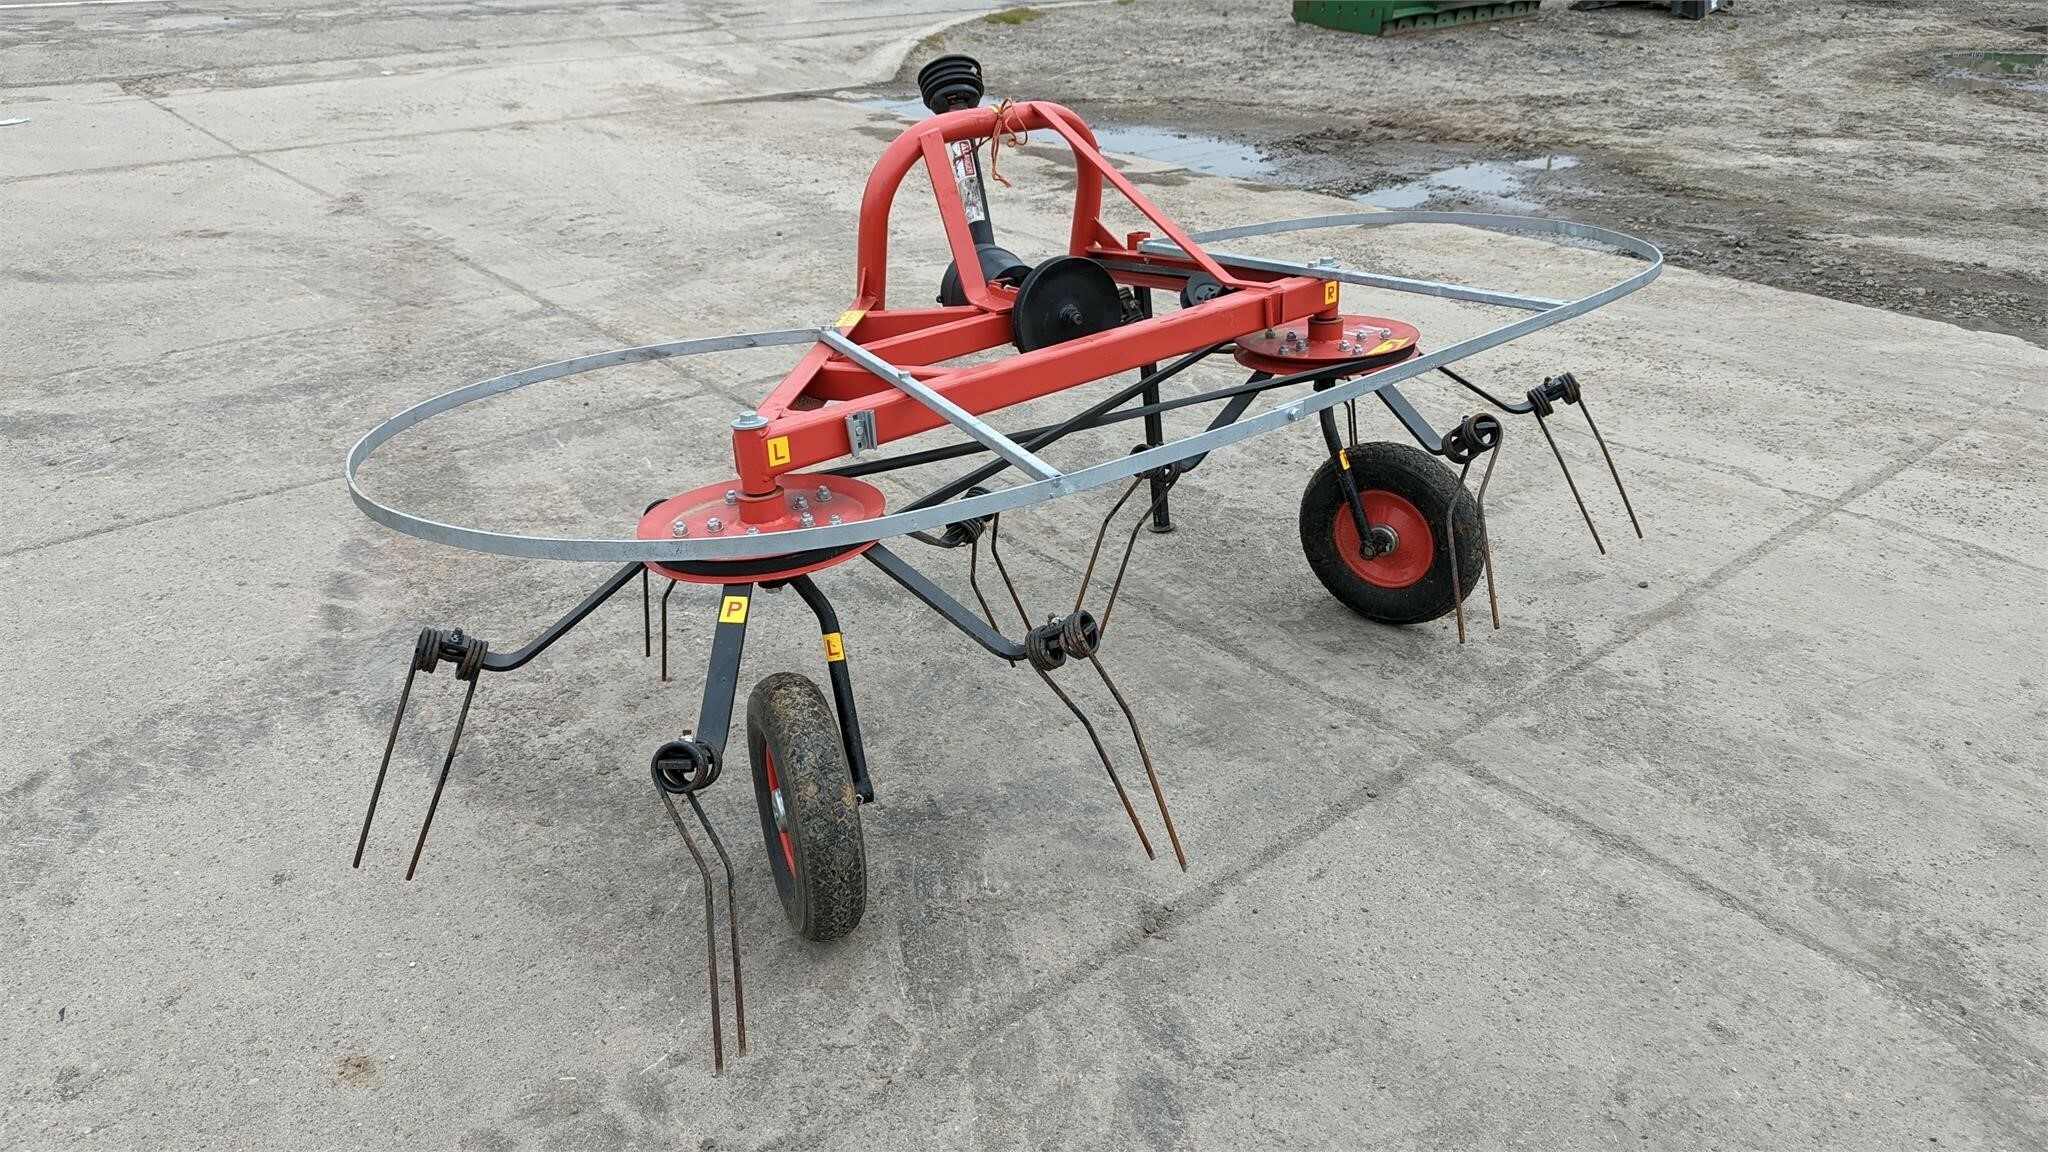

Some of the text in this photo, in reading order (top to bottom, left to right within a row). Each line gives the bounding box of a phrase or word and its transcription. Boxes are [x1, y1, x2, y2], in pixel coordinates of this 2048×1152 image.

[1327, 285, 1335, 300] R
[773, 443, 786, 460] L
[726, 601, 743, 617] P
[826, 639, 840, 656] L
